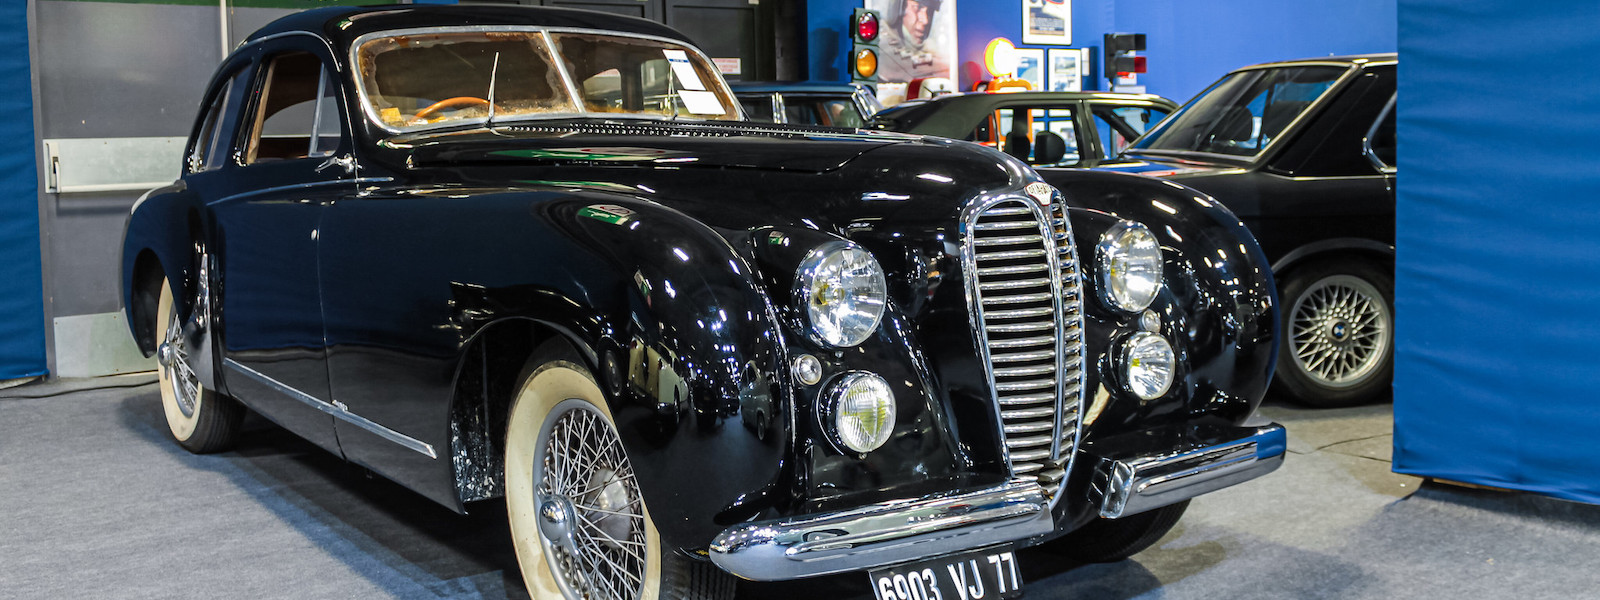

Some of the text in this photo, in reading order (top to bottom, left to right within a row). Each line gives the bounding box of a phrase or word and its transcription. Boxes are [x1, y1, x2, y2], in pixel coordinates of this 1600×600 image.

[878, 552, 1019, 600] 6903 VJ 77
